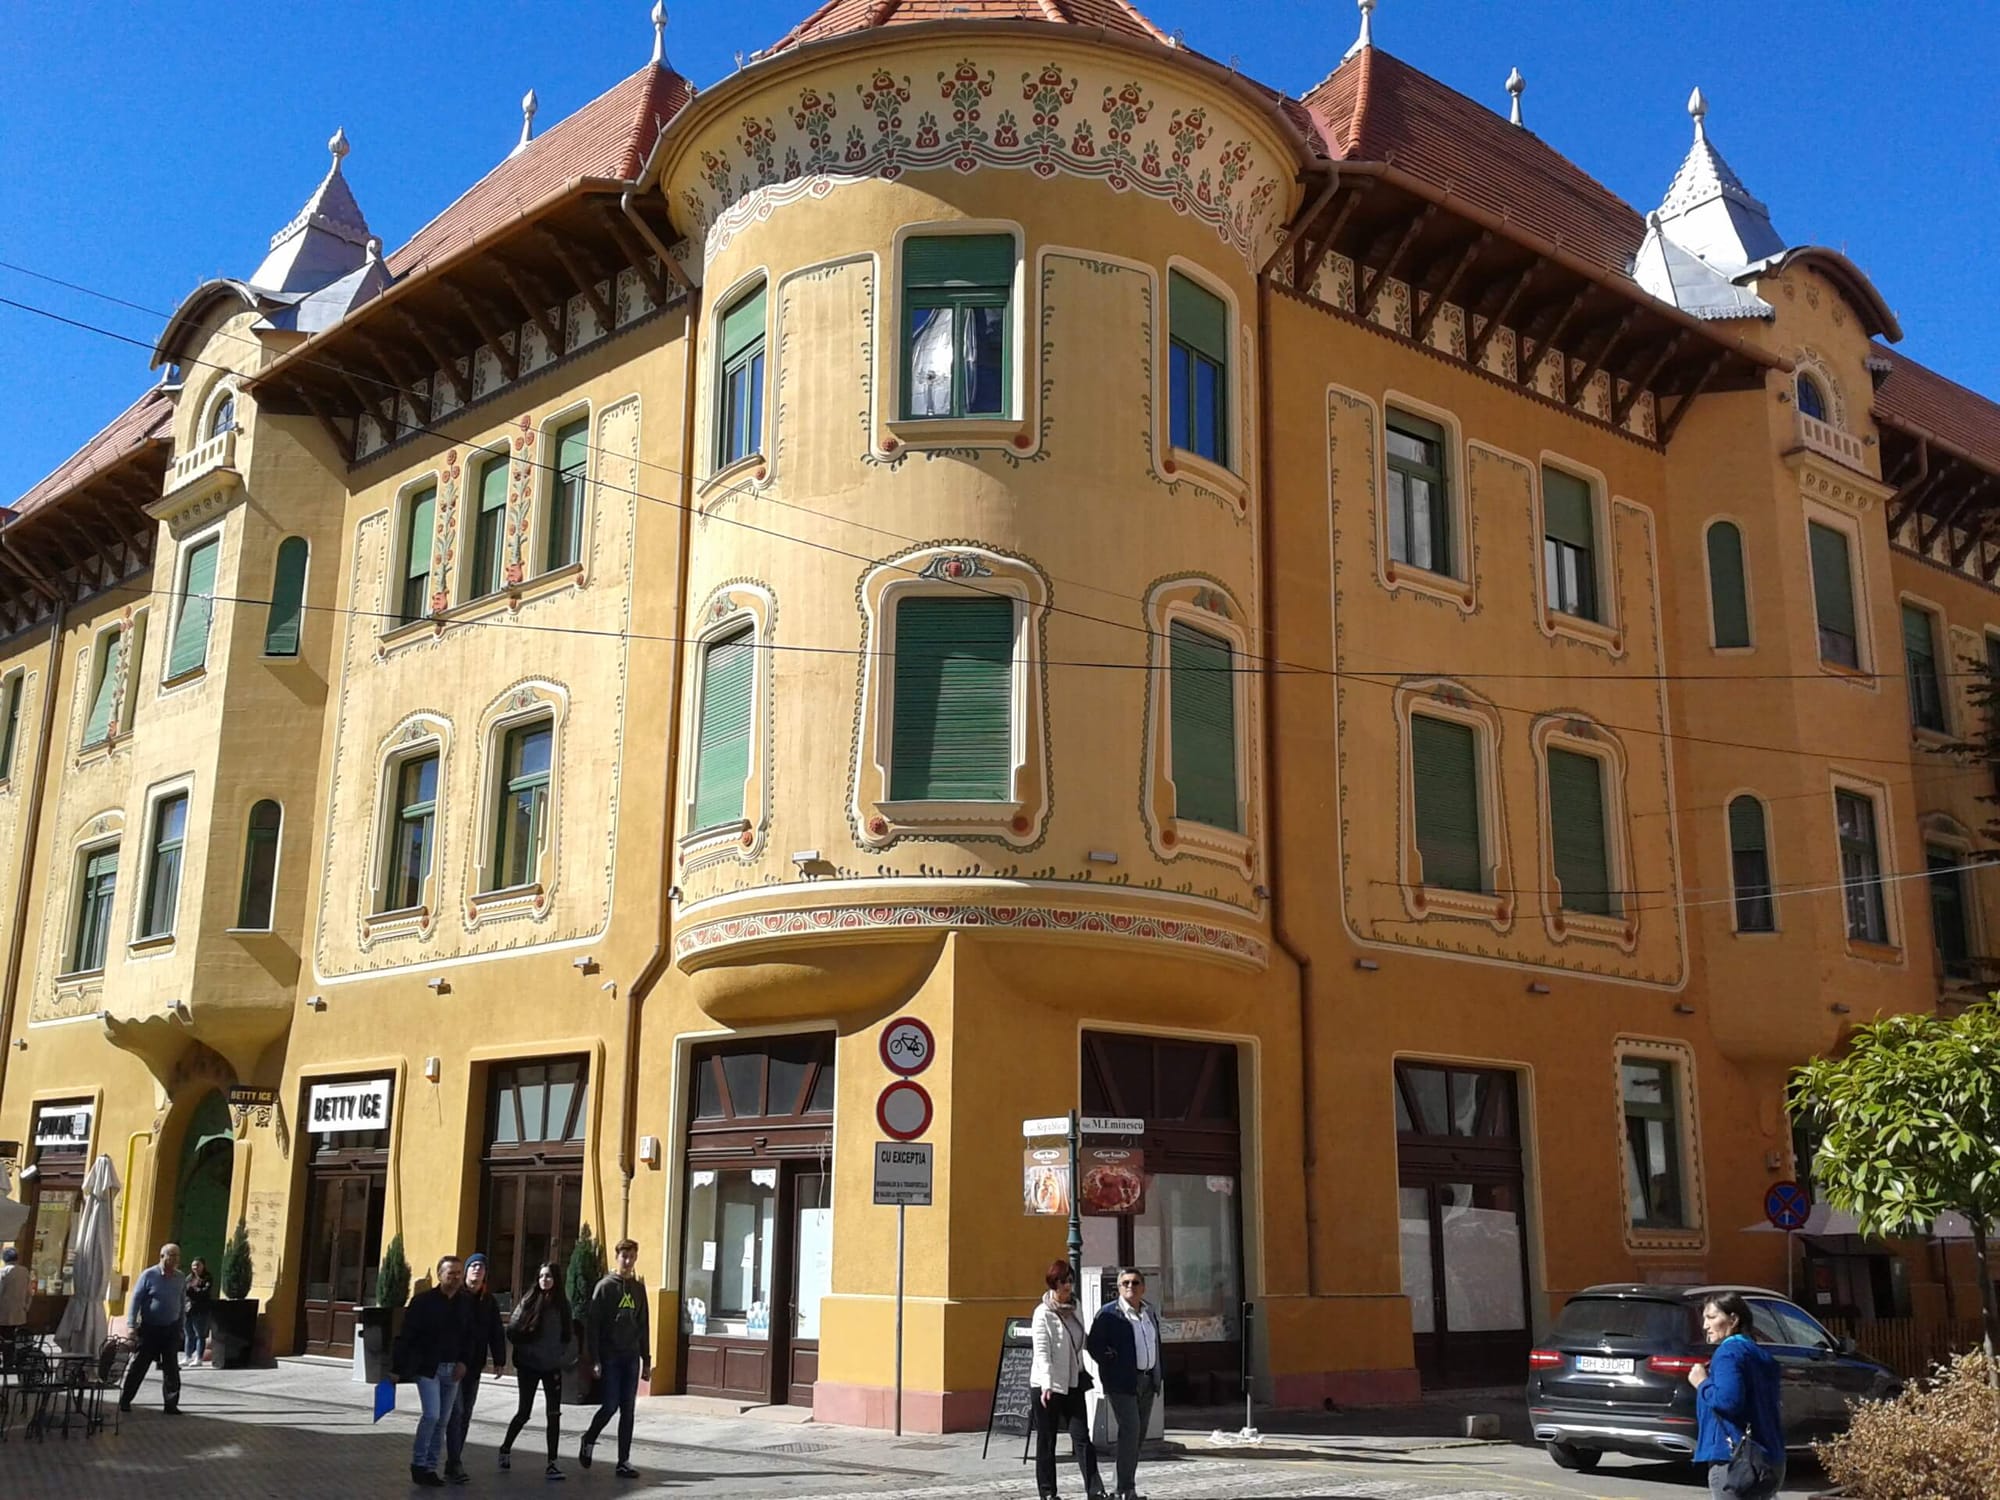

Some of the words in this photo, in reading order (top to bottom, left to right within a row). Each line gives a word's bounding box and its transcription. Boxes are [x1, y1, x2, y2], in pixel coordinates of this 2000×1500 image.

[231, 1090, 256, 1100] BETTY
[258, 1091, 273, 1100] ICE
[314, 1095, 357, 1122] BETTY
[359, 1093, 381, 1119] ICE
[881, 1150, 891, 1163] CU
